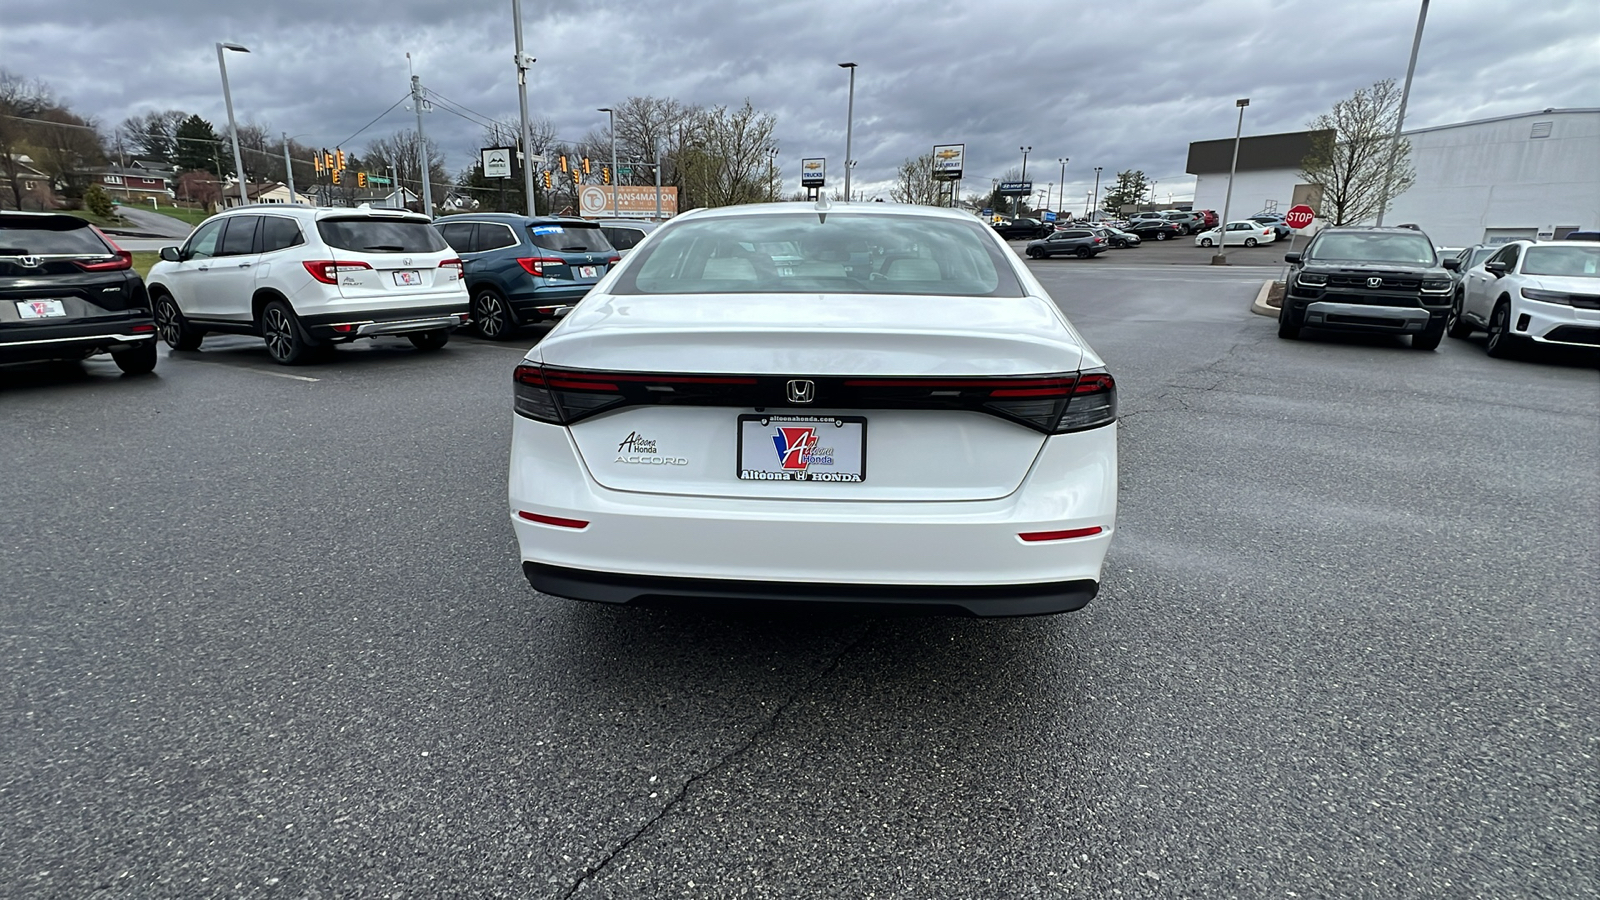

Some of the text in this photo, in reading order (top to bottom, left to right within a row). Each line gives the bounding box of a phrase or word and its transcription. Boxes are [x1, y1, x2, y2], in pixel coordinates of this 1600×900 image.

[606, 192, 676, 202] TANS4MATON
[1287, 211, 1313, 223] STOP
[769, 415, 835, 423] altoonahonda.com
[618, 431, 656, 453] Altoona
[614, 455, 688, 466] ACCORD
[802, 454, 833, 465] Honda
[741, 470, 790, 480] Altoona
[811, 473, 862, 482] HONDA
